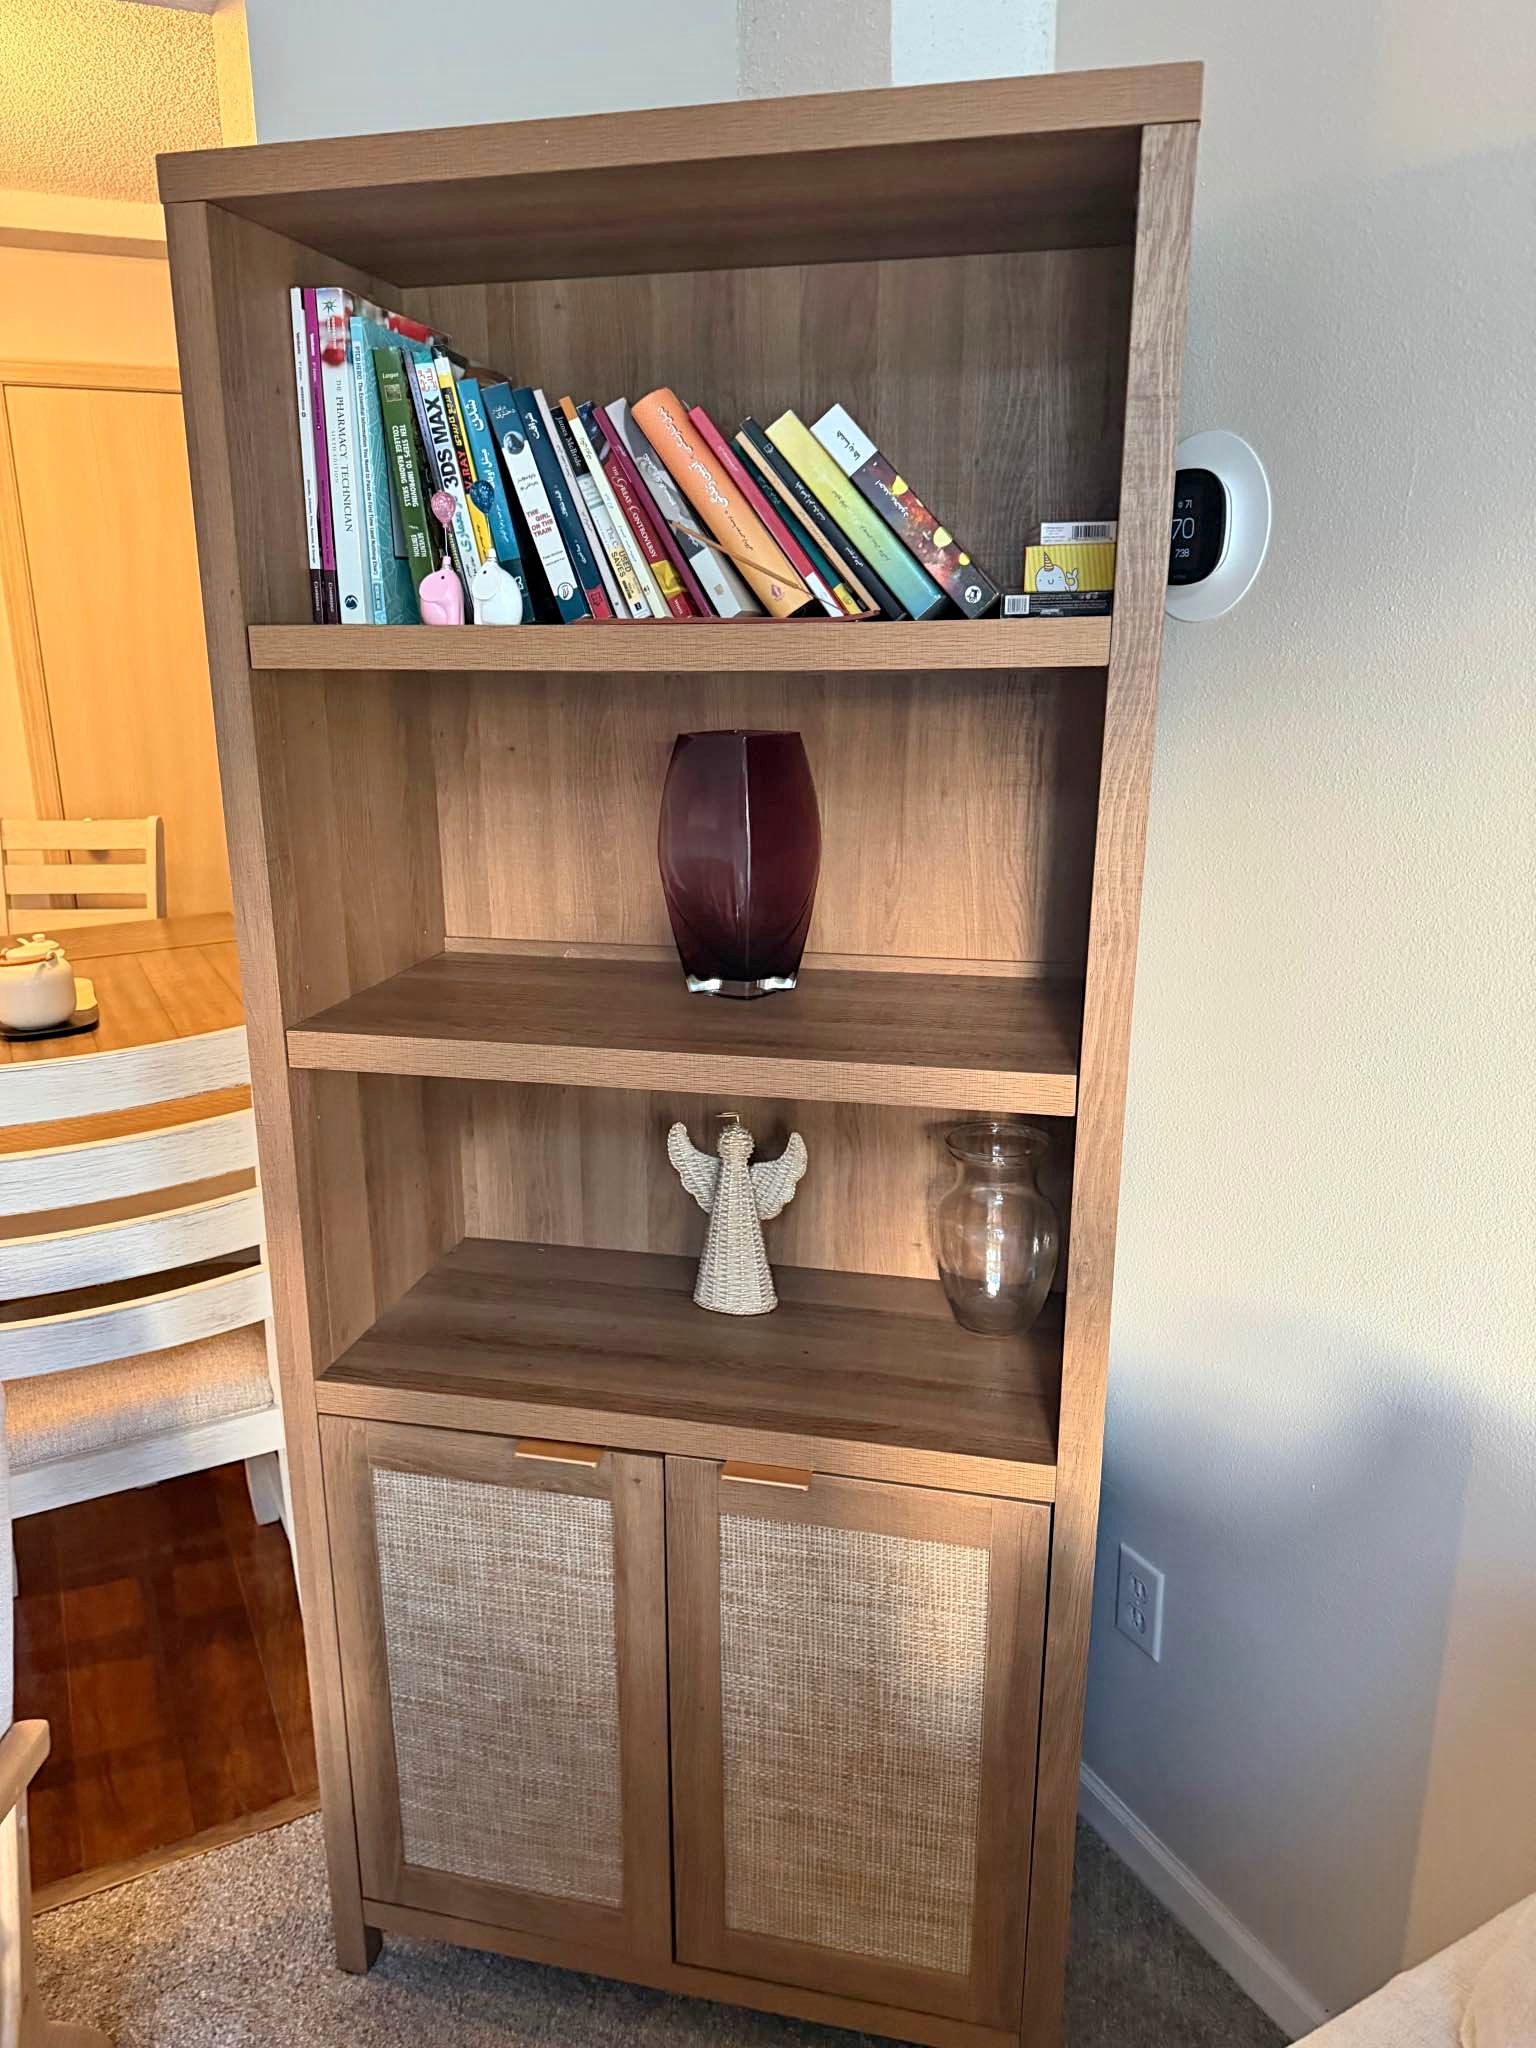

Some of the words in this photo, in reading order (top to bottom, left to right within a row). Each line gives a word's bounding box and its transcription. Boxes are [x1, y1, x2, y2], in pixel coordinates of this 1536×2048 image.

[335, 395, 347, 457] PHARMACY
[397, 423, 407, 437] TEN
[423, 395, 449, 445] MAX
[390, 424, 402, 453] COLLEGE
[400, 438, 411, 458] STEPS
[555, 414, 569, 437] James
[564, 436, 582, 468] McBride
[395, 454, 408, 484] READING
[404, 459, 413, 469] TO
[435, 447, 459, 490] 3DS
[457, 449, 473, 491] V.RAY
[340, 463, 353, 532] TECHNICIAN
[401, 485, 412, 507] SKILLS
[406, 470, 419, 507] IMPROVING
[701, 477, 730, 512] زندگی
[525, 508, 539, 517] THE
[534, 511, 551, 522] GIRL
[613, 473, 634, 504] GREAT
[627, 504, 659, 558] CONTROVERSY
[888, 493, 912, 519] محمود
[451, 510, 472, 553] معماری
[530, 523, 540, 531] ON
[540, 518, 553, 527] THE
[532, 526, 552, 538] TRAIN
[1172, 517, 1195, 540] 70
[409, 533, 420, 558] EDITION
[416, 532, 427, 558] SEVENTH
[609, 550, 627, 578] SAVES
[617, 549, 632, 573] USED
